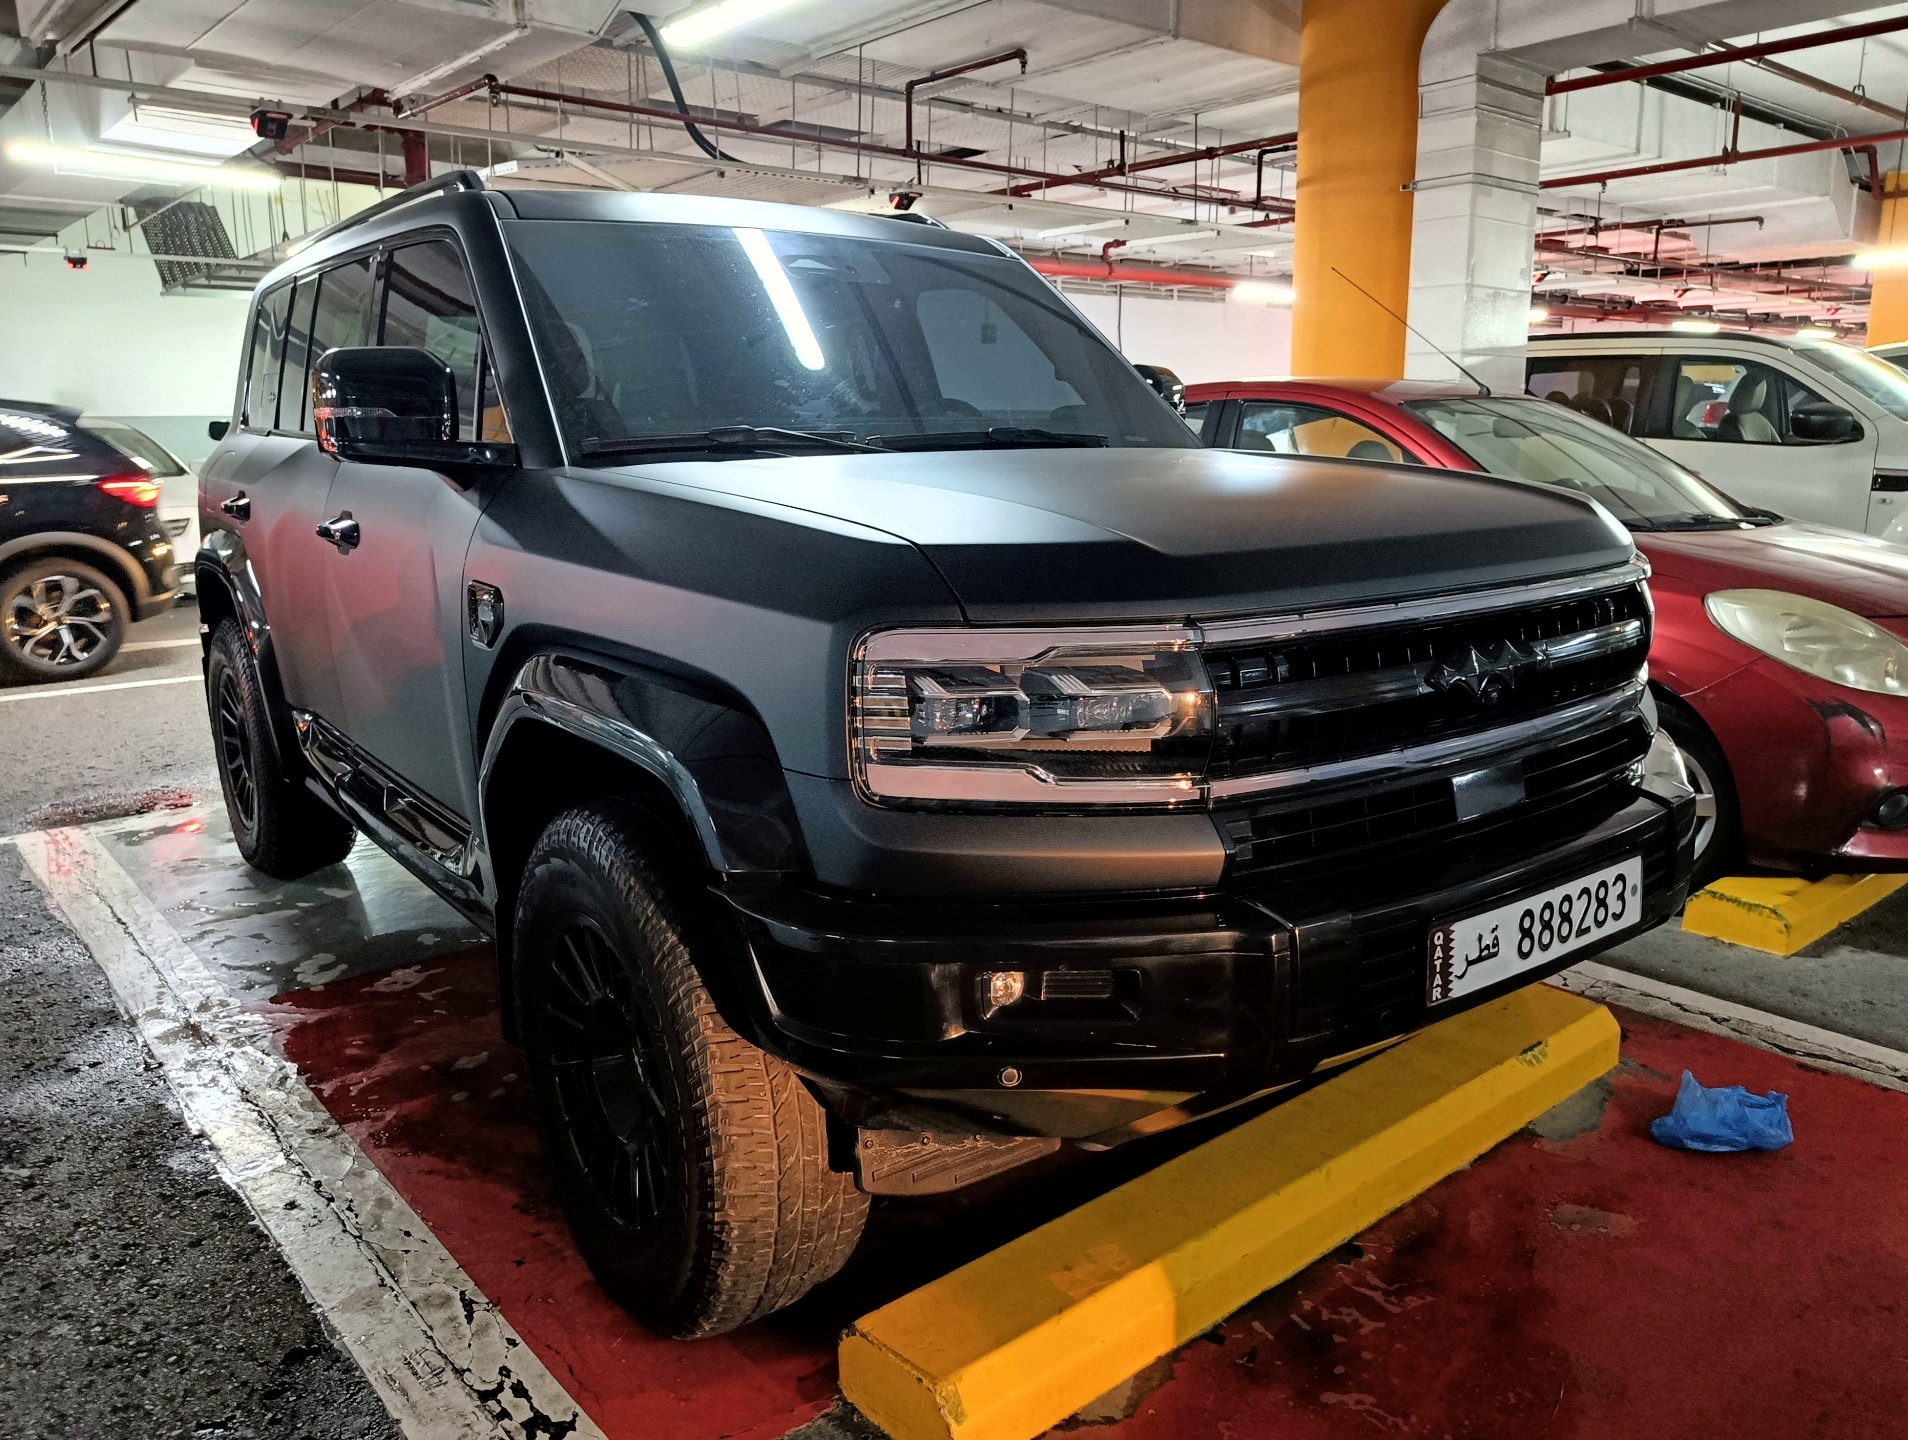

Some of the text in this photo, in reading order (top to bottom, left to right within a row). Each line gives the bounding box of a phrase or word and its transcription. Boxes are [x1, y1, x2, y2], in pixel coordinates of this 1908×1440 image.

[1517, 872, 1627, 960] 888283
[1432, 931, 1444, 1001] QATAR
[1454, 924, 1500, 980] قطر
